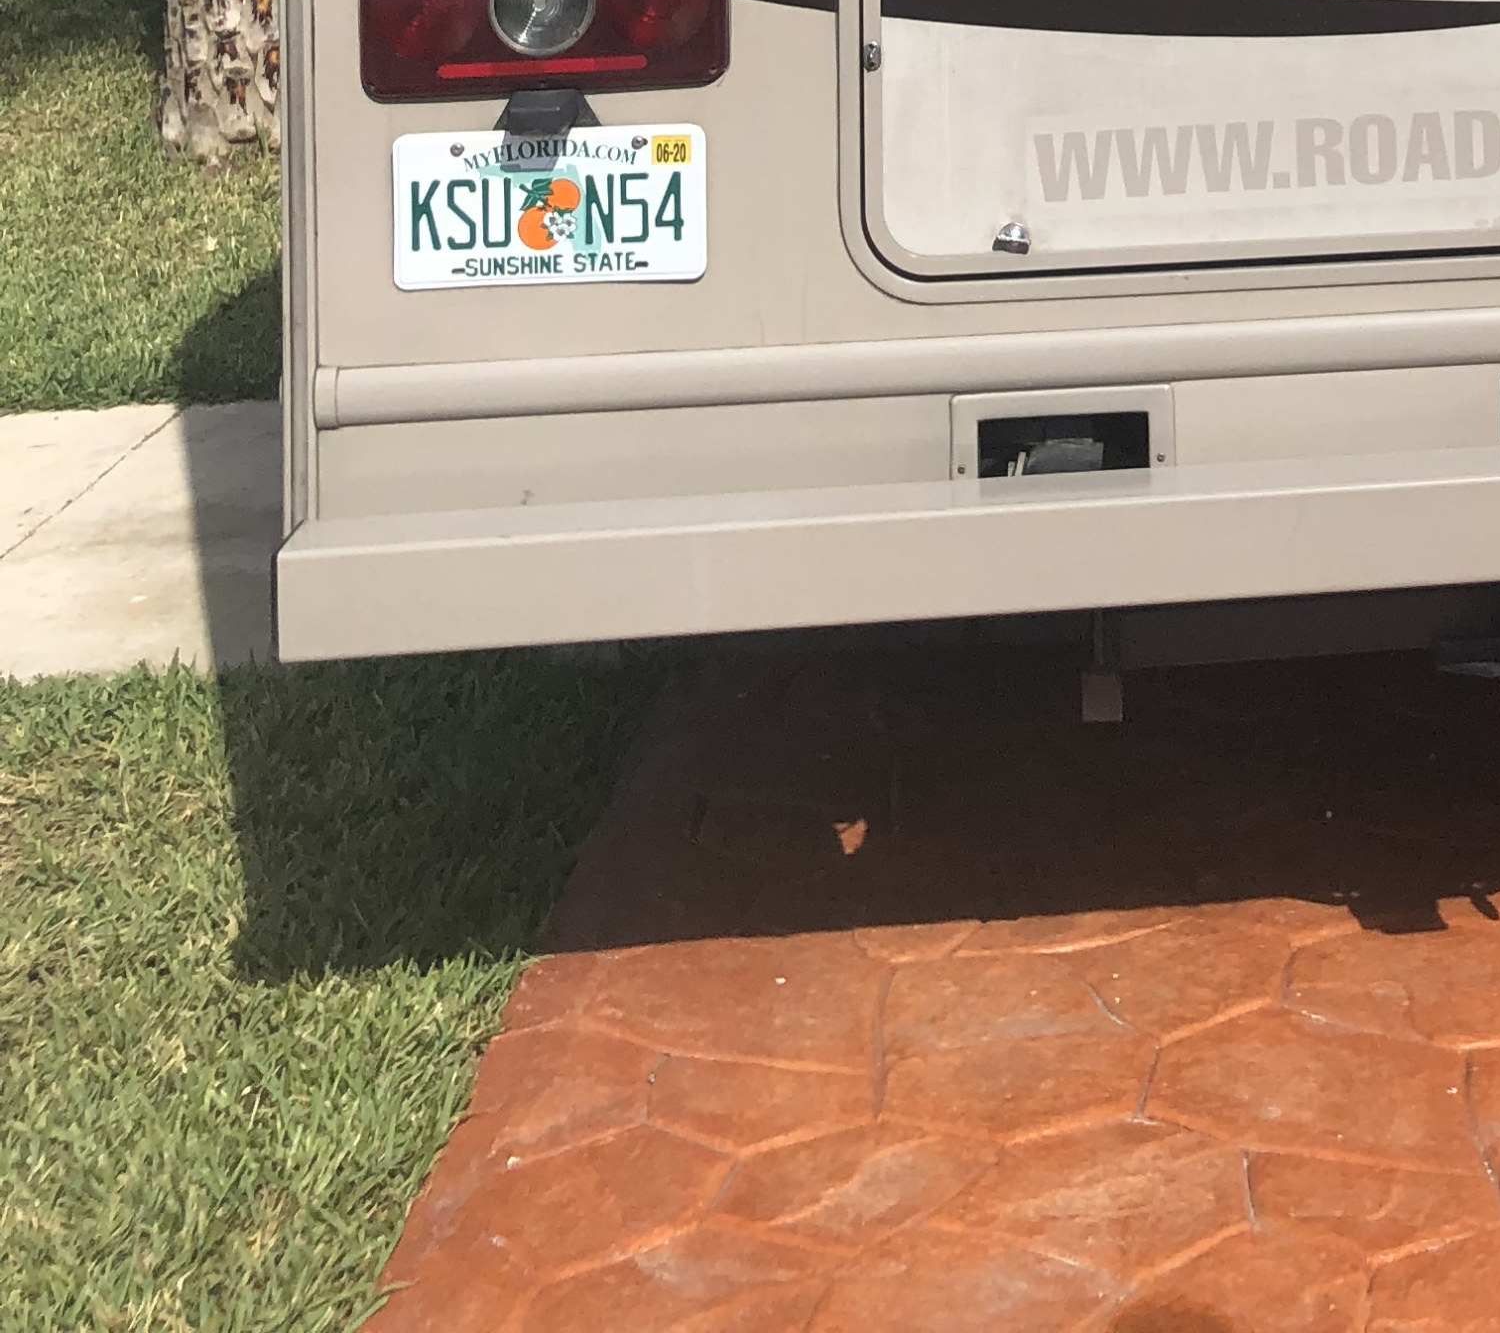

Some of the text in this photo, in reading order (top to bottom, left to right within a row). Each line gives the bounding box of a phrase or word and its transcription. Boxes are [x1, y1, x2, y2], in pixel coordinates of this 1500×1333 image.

[463, 138, 637, 172] MYFLORIDA.COM
[656, 142, 687, 163] 06-20
[410, 171, 685, 251] KSU N54
[465, 252, 636, 276] SUNSHINE STATE
